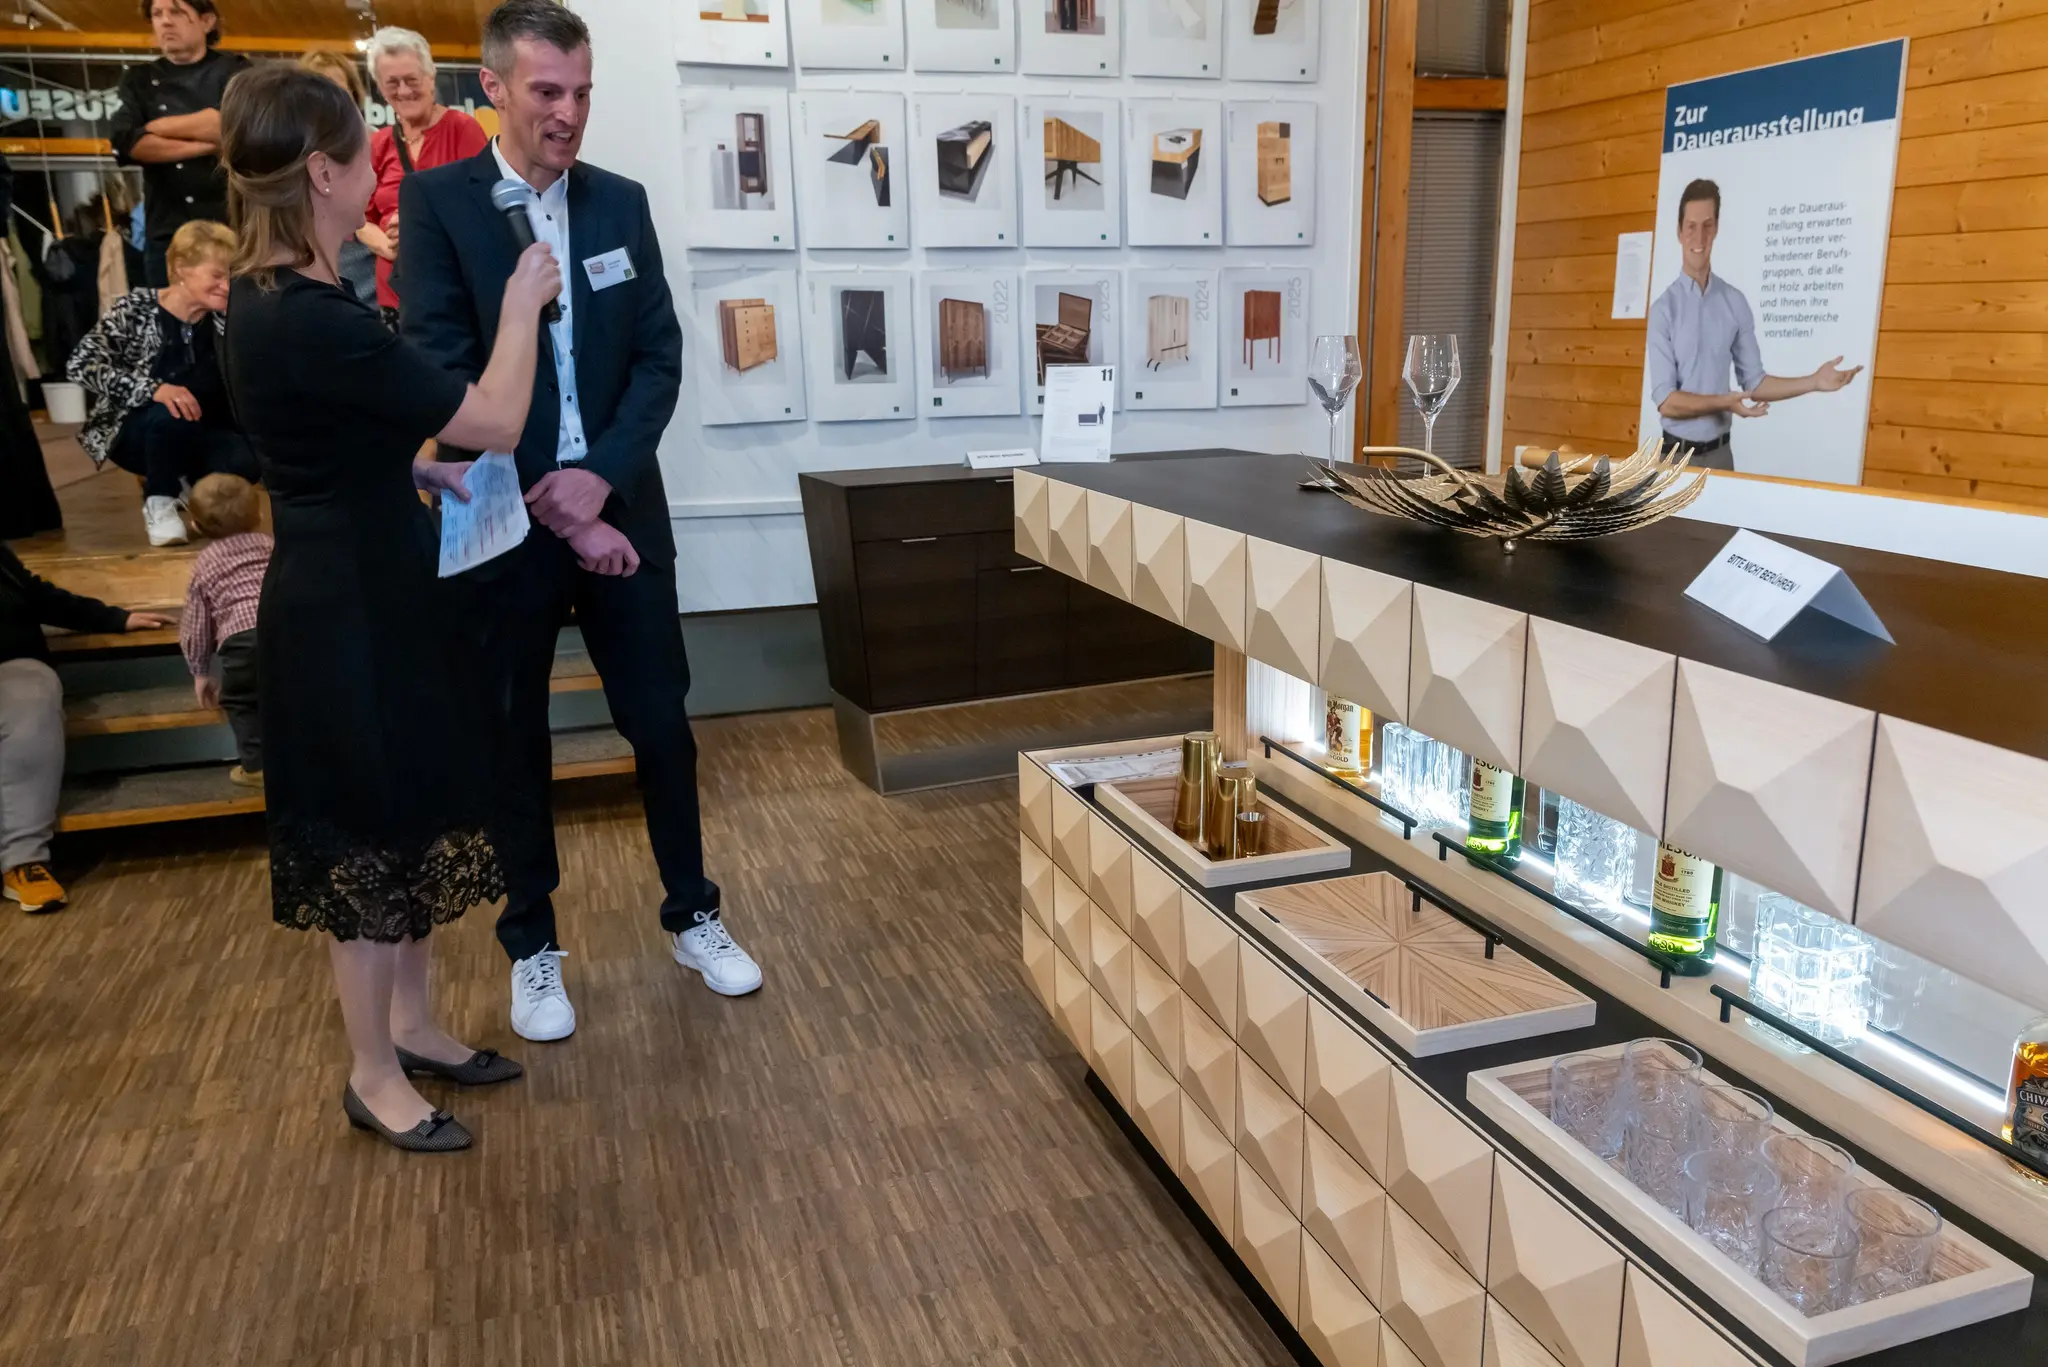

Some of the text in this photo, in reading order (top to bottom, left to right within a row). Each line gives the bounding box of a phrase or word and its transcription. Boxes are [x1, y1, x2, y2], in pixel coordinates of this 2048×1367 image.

[1674, 105, 1708, 127] Zur
[1673, 106, 1865, 152] Dauerausstellung
[1768, 201, 1847, 216] In der Daueraus-
[1767, 217, 1852, 232] stellung erwarten
[1765, 234, 1847, 247] Sie Vertreter ver-
[1764, 248, 1852, 263] schiedener Berufs-
[1762, 264, 1844, 280] gruppen, die alle
[1761, 281, 1844, 293] mit Holz arbeiten
[993, 279, 1009, 324] 2022
[1097, 279, 1111, 323] 2023
[1195, 280, 1209, 321] 2024
[1288, 276, 1302, 319] 2025
[1760, 296, 1829, 308] und Ihnen ihre
[1762, 313, 1839, 323] Wissensbereiche
[1764, 328, 1814, 338] vorstellen!
[1101, 368, 1113, 381] 11
[1727, 554, 1747, 569] BITTE
[1743, 561, 1765, 576] NICHT
[1333, 754, 1349, 763] GOLD
